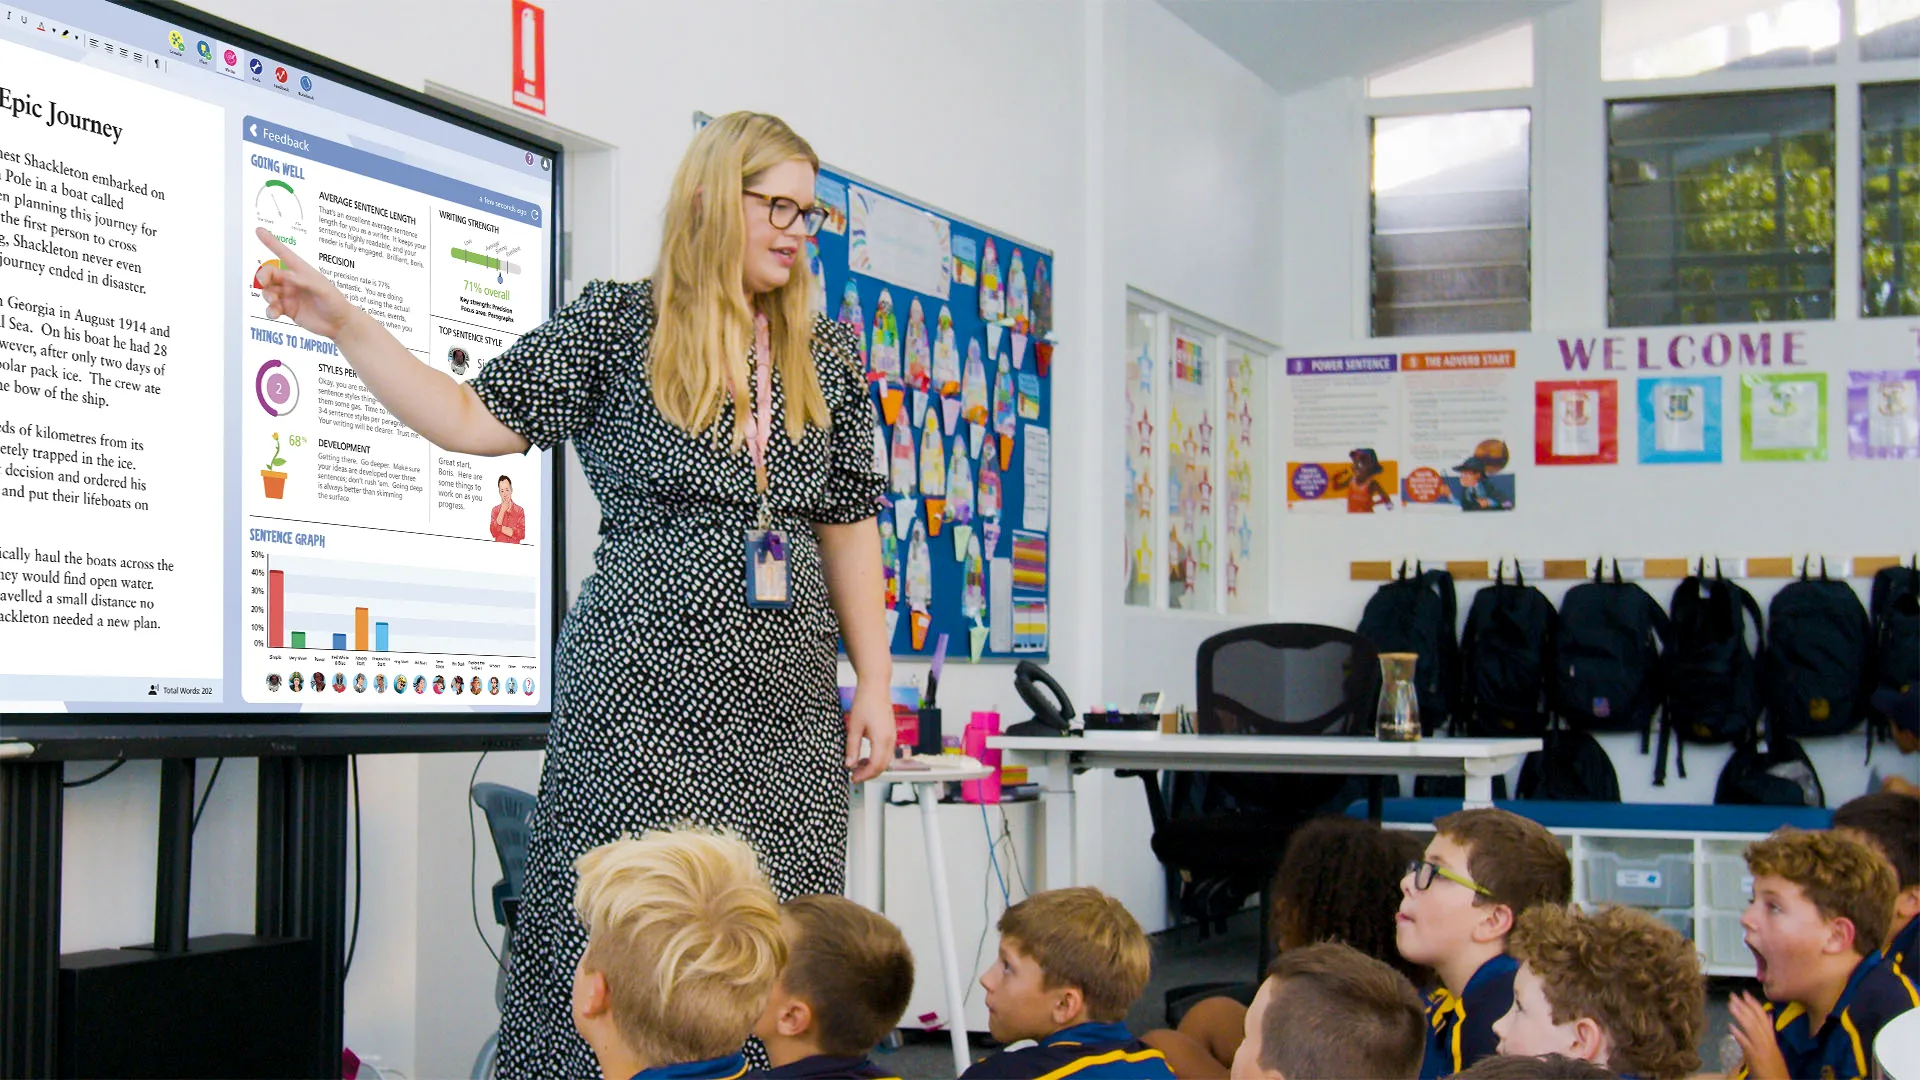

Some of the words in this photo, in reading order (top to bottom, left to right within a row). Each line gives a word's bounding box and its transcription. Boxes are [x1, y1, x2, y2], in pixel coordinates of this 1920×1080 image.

[0, 87, 42, 118] Epic
[46, 101, 123, 145] Journey
[263, 128, 310, 152] Feedback
[24, 153, 88, 180] Shackleton
[92, 174, 147, 196] embarked
[151, 190, 165, 200] on
[251, 154, 280, 173] GOING
[282, 162, 305, 180] WELL
[5, 169, 32, 187] Pole
[36, 178, 47, 191] in
[51, 185, 57, 193] a
[62, 182, 88, 201] boat
[91, 193, 123, 210] called
[319, 191, 353, 208] AVERAGE
[354, 200, 388, 218] SENTENCE
[390, 211, 416, 225] LENGTH
[484, 196, 494, 206] few
[495, 200, 516, 212] seconds
[14, 193, 67, 219] planning
[71, 206, 91, 222] this
[95, 216, 137, 235] journey
[141, 223, 157, 236] for
[439, 210, 467, 225] WRITING
[468, 218, 499, 234] STRENGTH
[13, 234, 78, 259] Shackleton
[82, 253, 113, 267] never
[116, 261, 141, 273] even
[319, 252, 355, 269] PRECISION
[0, 256, 45, 276] journey
[49, 265, 83, 281] ended
[87, 272, 98, 284] in
[102, 274, 146, 294] disaster.
[464, 279, 482, 294] 71%
[484, 287, 510, 301] overall
[460, 296, 469, 304] Key
[492, 304, 512, 314] Precision
[461, 305, 475, 314] Focus
[8, 296, 55, 317] Georgia
[60, 307, 70, 319] in
[74, 309, 115, 327] August
[119, 318, 146, 333] 1914
[150, 326, 170, 338] and
[250, 327, 283, 346] THINGS
[286, 334, 297, 348] TO
[300, 336, 339, 356] IMPROVE
[439, 325, 452, 336] TOP
[453, 329, 483, 343] SENTENCE
[485, 336, 502, 347] STYLE
[40, 344, 68, 359] after
[72, 351, 97, 367] only
[101, 357, 122, 368] two
[126, 358, 150, 375] days
[154, 364, 166, 375] of
[1424, 356, 1441, 367] THE
[1443, 355, 1480, 367] ADVERB
[1483, 353, 1510, 366] START
[1557, 331, 1808, 371] WELCOME
[318, 363, 343, 376] STYLES
[1345, 357, 1391, 371] SENTENCE
[30, 365, 58, 378] pack
[63, 369, 81, 382] ice.
[89, 372, 111, 386] The
[115, 380, 141, 391] crew
[145, 385, 161, 394] ate
[275, 382, 282, 395] 2
[19, 424, 32, 436] of
[36, 425, 96, 444] kilometres
[100, 434, 127, 448] from
[131, 439, 144, 450] its
[318, 438, 371, 454] DEVELOPMENT
[438, 457, 455, 466] Great
[5, 463, 54, 480] decision
[58, 471, 79, 483] and
[84, 473, 127, 488] ordered
[131, 477, 146, 491] his
[458, 471, 472, 479] Here
[455, 481, 473, 491] things
[2, 485, 24, 498] and
[29, 491, 49, 502] put
[52, 489, 79, 503] their
[84, 492, 131, 508] lifeboats
[135, 502, 148, 510] on
[249, 528, 293, 544] SENTENCE
[295, 533, 325, 548] GRAPH
[251, 550, 265, 558] 50%
[22, 570, 60, 583] would
[64, 571, 86, 585] find
[90, 578, 117, 589] open
[121, 580, 153, 589] water.
[251, 568, 265, 577] 40%
[251, 587, 264, 595] 30%
[57, 593, 87, 605] small
[91, 593, 136, 608] distance
[140, 601, 154, 609] no
[251, 605, 264, 614] 20%
[53, 613, 93, 626] needed
[97, 618, 103, 626] a
[107, 619, 130, 627] new
[134, 616, 160, 631] plan.
[251, 624, 264, 632] 10%
[202, 687, 213, 695] 202
